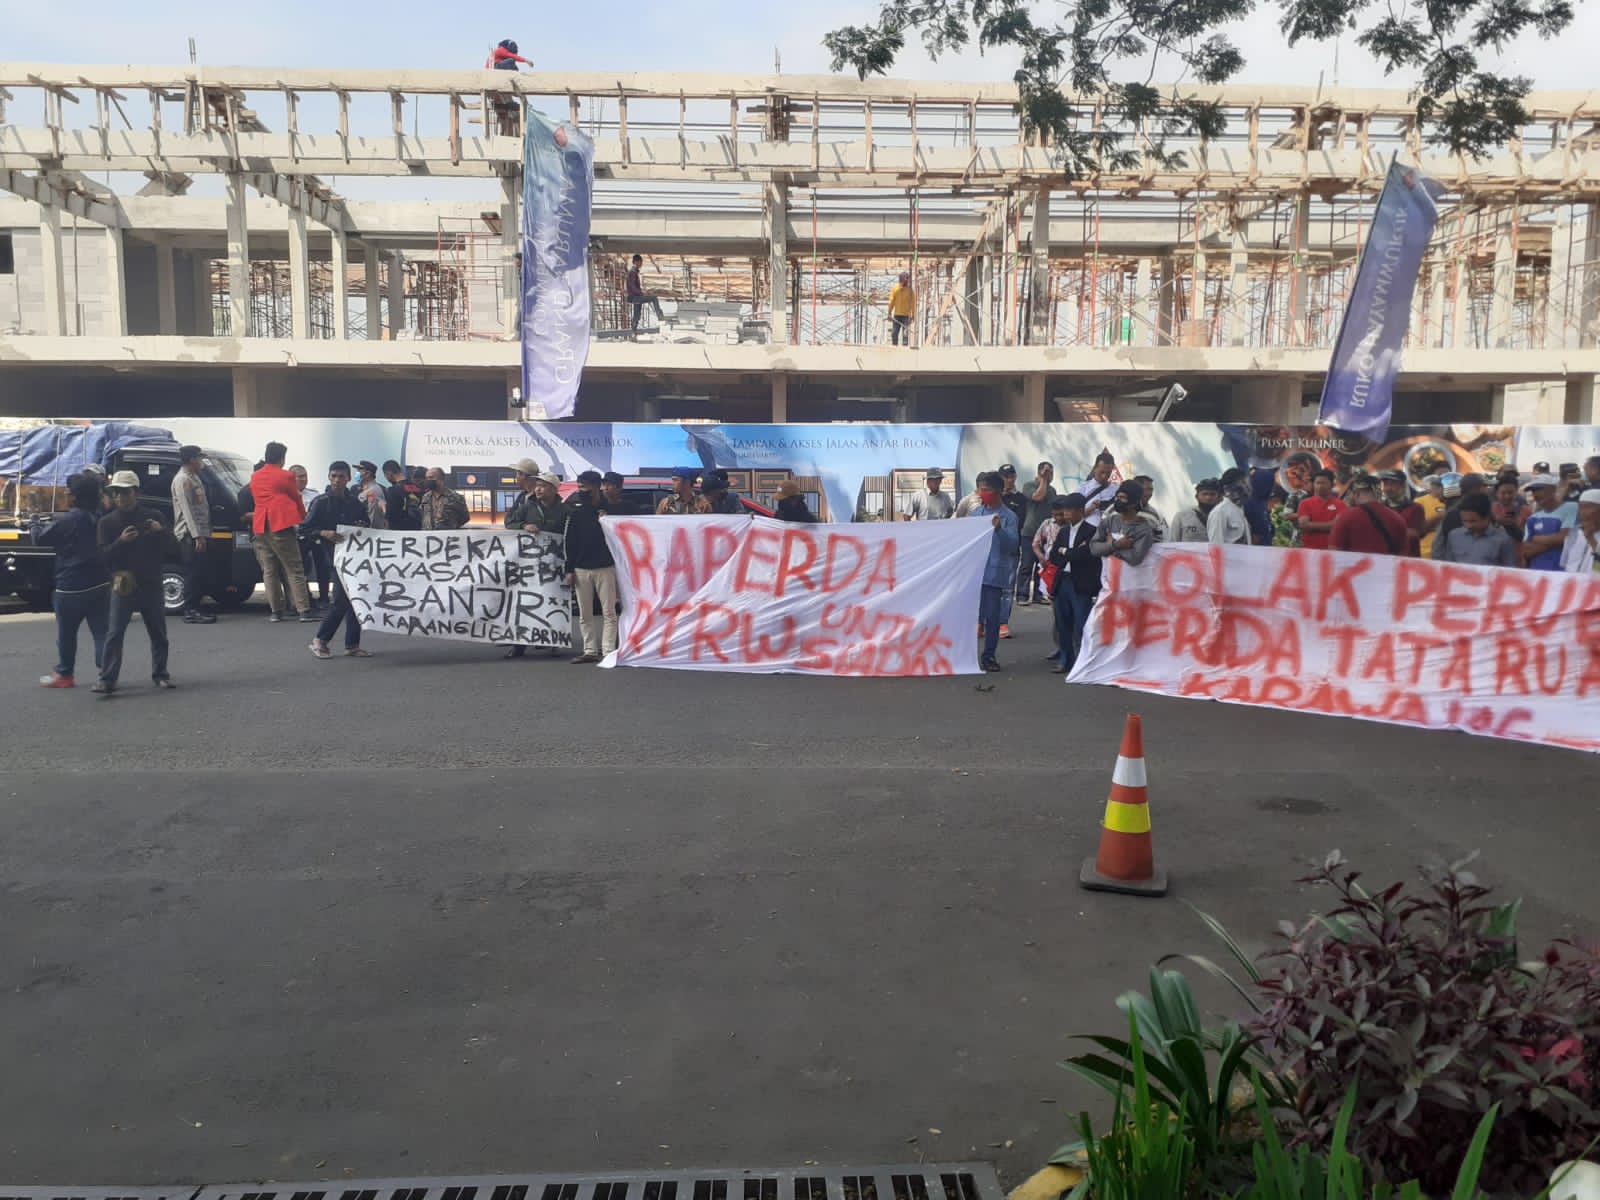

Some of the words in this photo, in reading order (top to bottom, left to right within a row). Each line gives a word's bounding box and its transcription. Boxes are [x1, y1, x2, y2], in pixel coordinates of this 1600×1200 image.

[424, 433, 472, 447] TAMPAK
[474, 436, 484, 447] &
[487, 435, 521, 447] AKSES
[731, 437, 777, 449] TAMPAK
[778, 438, 787, 449] &
[790, 439, 823, 449] AKSES
[825, 437, 859, 449] JALAN
[902, 437, 931, 449] BLOK
[1260, 436, 1297, 449] PUSAT
[1299, 437, 1345, 449] KULINER
[346, 533, 505, 562] MERDEKA
[615, 522, 898, 598] RAPERDA
[341, 556, 499, 585] KAWASAN
[375, 581, 551, 628] BANJIR
[1100, 597, 1303, 677] PERDA
[1318, 625, 1474, 697] TATA
